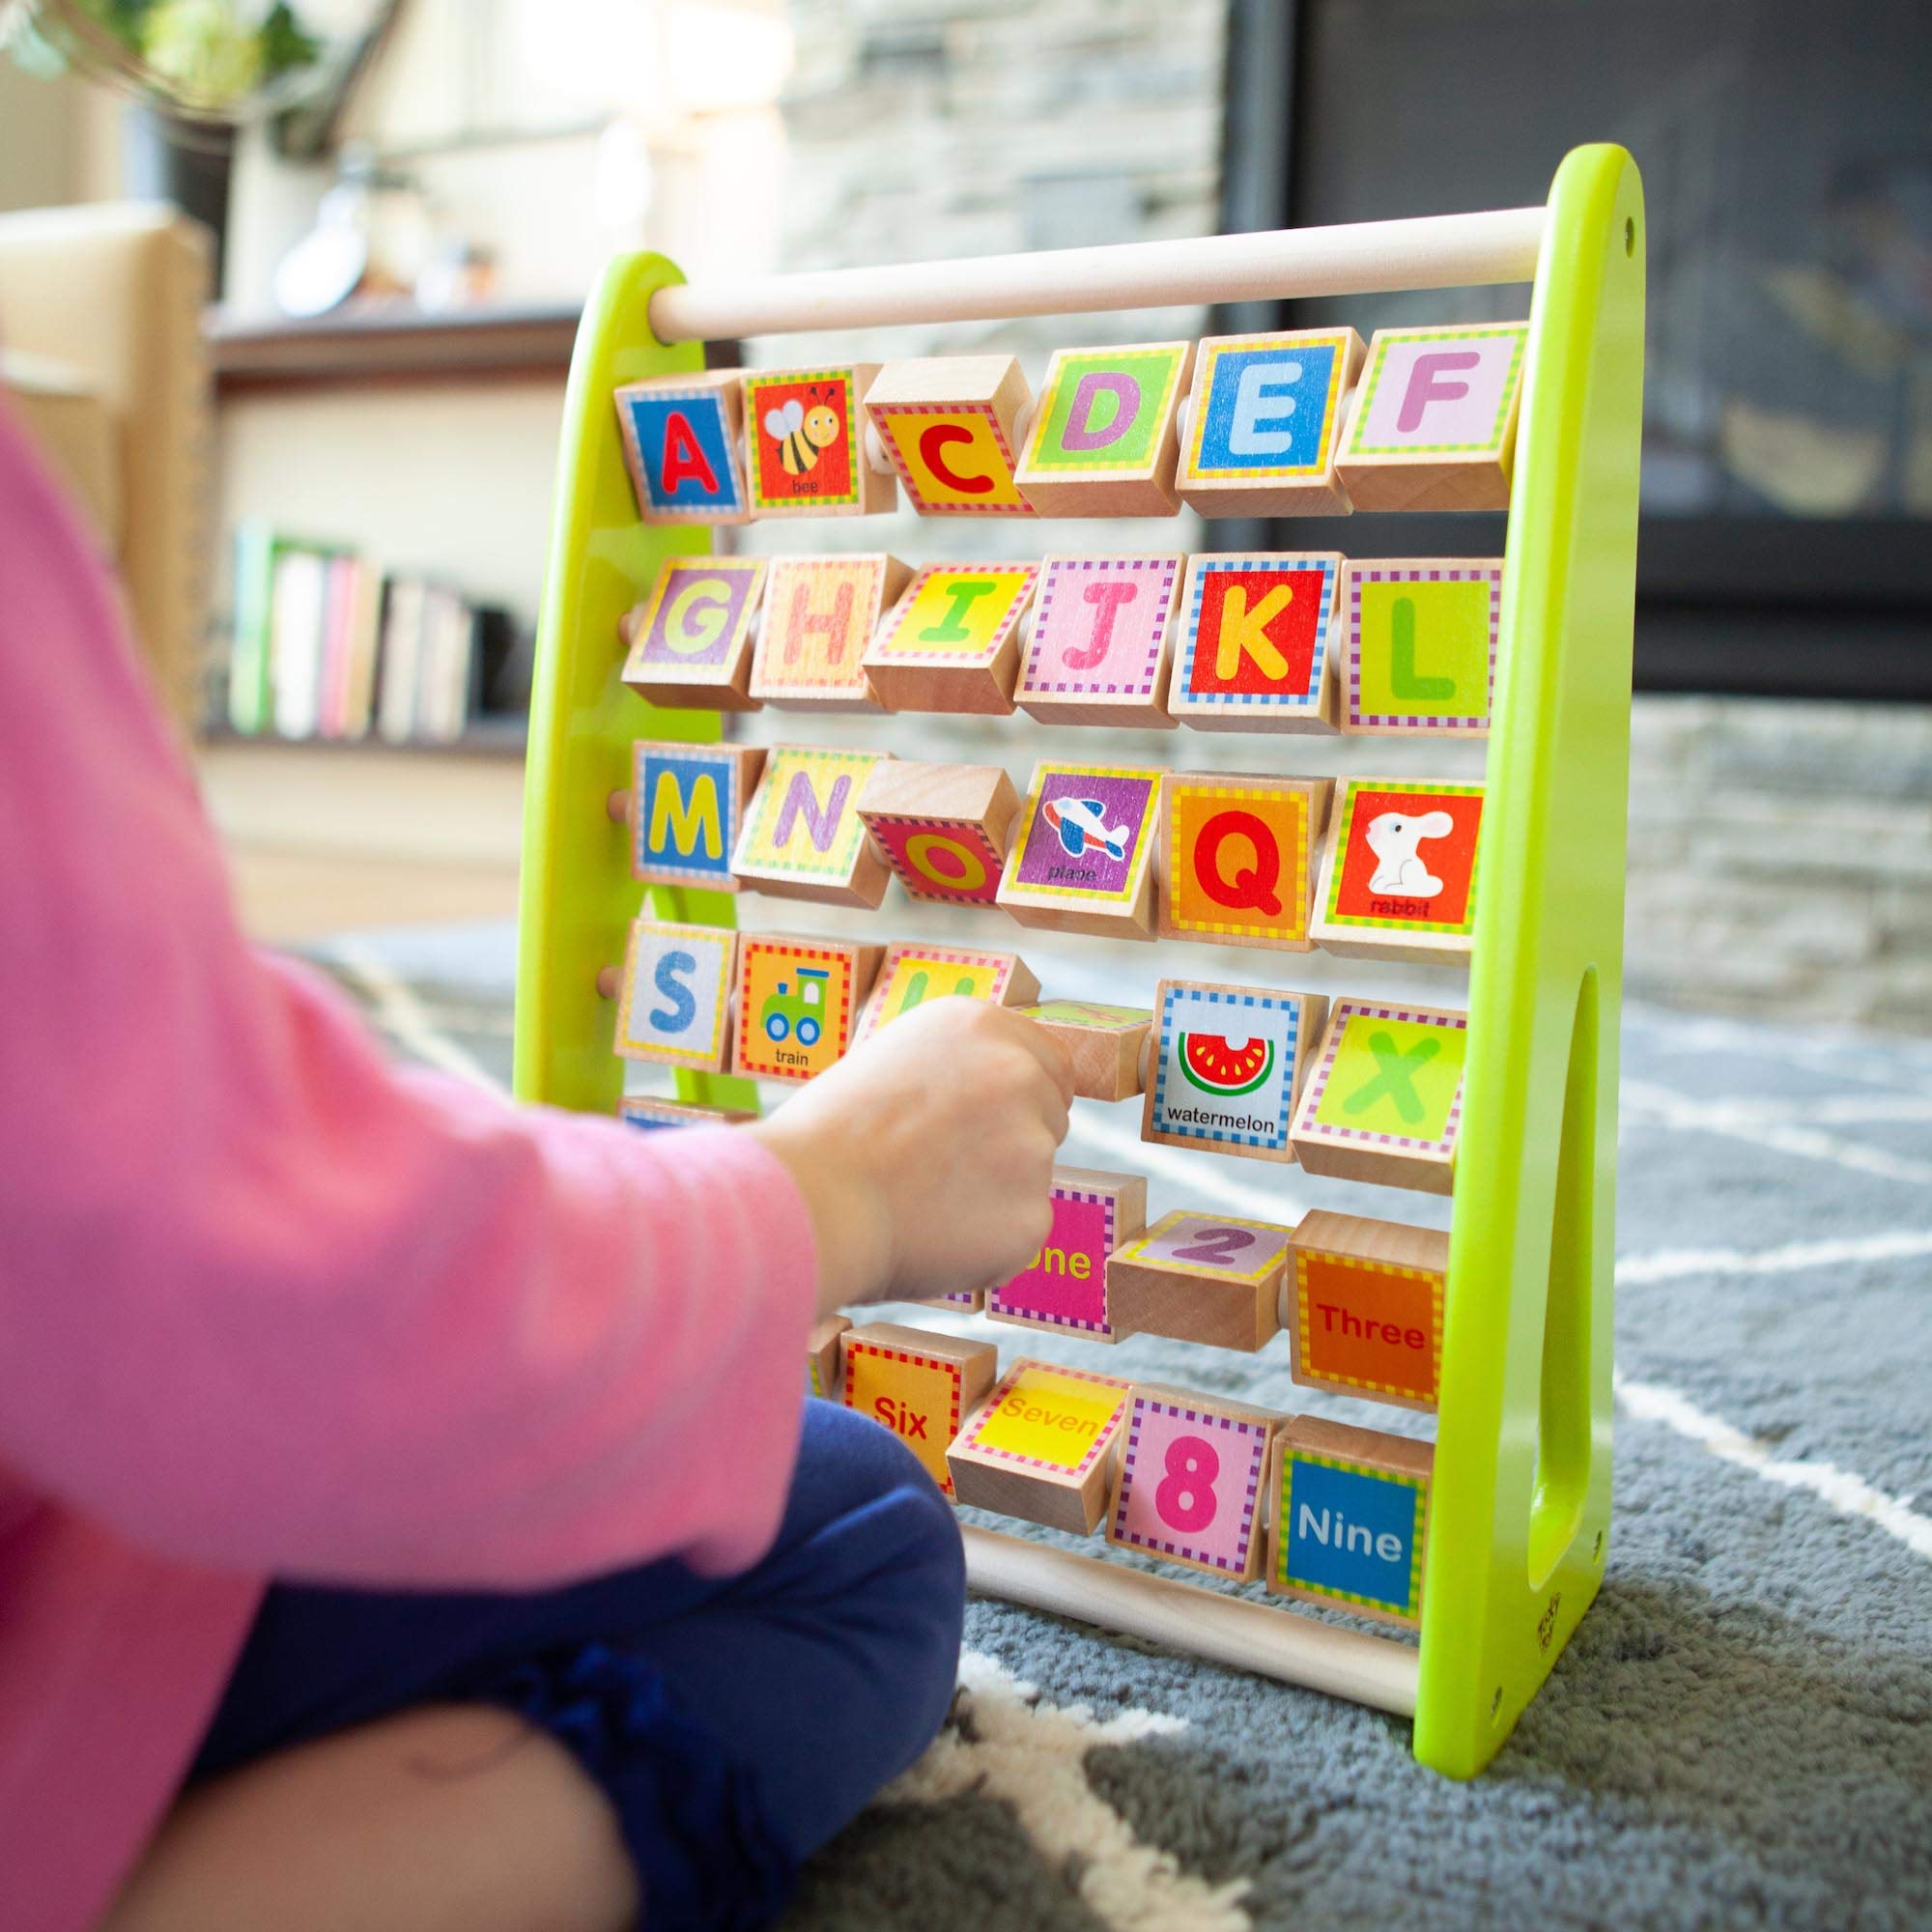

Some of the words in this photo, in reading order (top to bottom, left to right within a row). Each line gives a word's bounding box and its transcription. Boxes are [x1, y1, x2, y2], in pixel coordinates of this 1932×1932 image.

[1061, 372, 1141, 451] D
[1228, 362, 1302, 455] E
[1396, 352, 1481, 433] F
[662, 411, 720, 495] A
[792, 479, 819, 494] bee
[919, 423, 995, 494] C
[664, 579, 733, 655] G
[783, 582, 854, 666] H
[918, 582, 997, 642] I
[1062, 582, 1138, 670] J
[1215, 583, 1293, 681] K
[1391, 597, 1456, 700] L
[648, 770, 724, 860] M
[772, 770, 852, 853] N
[904, 834, 987, 892] O
[1047, 866, 1097, 881] plane
[1193, 810, 1283, 917] Q
[1370, 898, 1430, 918] rabbit
[648, 951, 696, 1034] S
[776, 1048, 809, 1066] train
[1342, 1031, 1441, 1125] X
[1167, 1105, 1275, 1135] watermelon
[1026, 1246, 1092, 1280] ne
[1171, 1227, 1257, 1265] 2
[1316, 1302, 1426, 1350] Three
[873, 1397, 927, 1439] Six
[1001, 1397, 1100, 1438] Seven
[1154, 1435, 1221, 1534] 8
[1297, 1502, 1404, 1563] Nine
